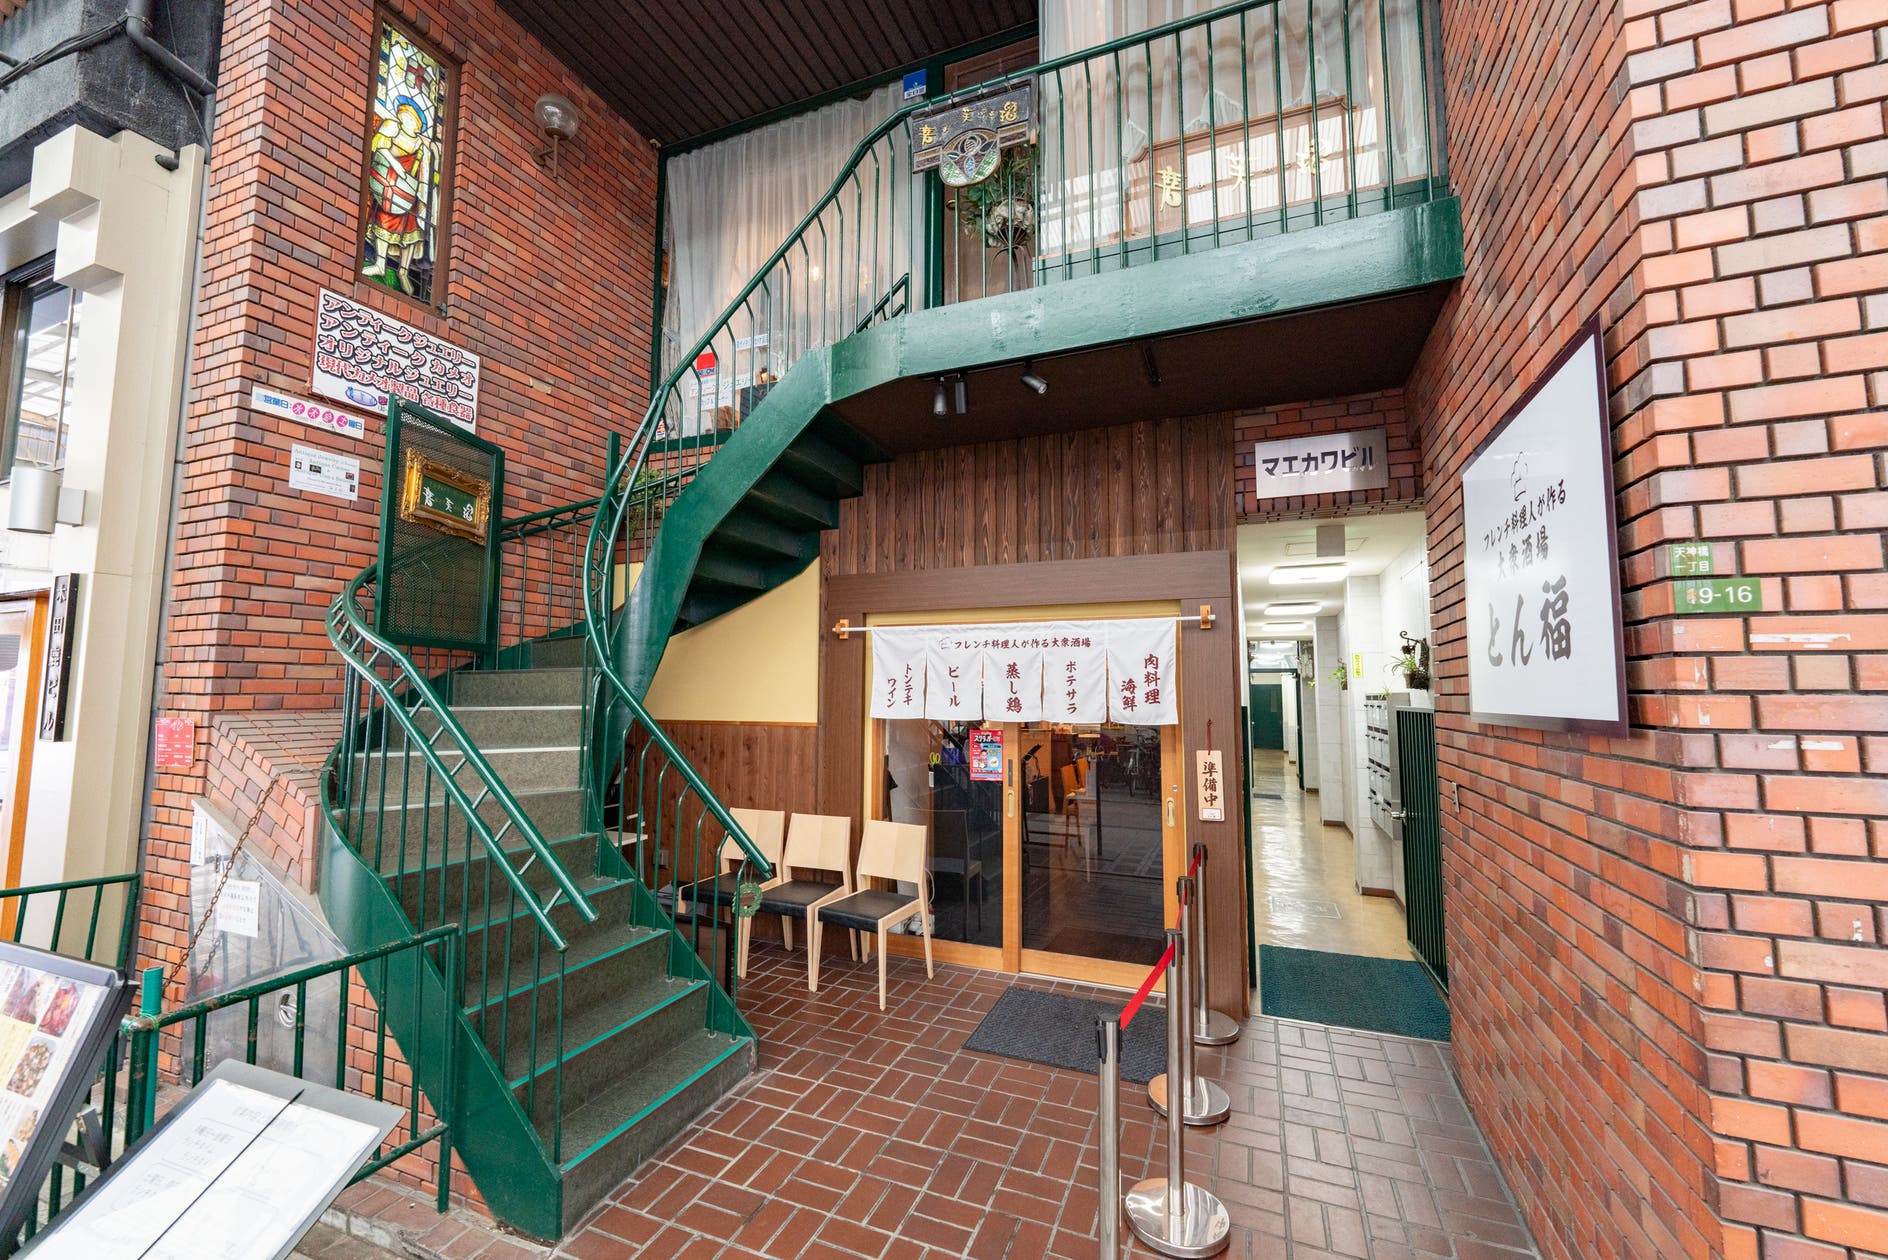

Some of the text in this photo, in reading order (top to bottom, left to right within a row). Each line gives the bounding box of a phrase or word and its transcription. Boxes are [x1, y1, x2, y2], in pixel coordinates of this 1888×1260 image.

[324, 294, 476, 368] アンティークジュエリー
[318, 334, 474, 401] オリジナルジュエリー
[1262, 446, 1374, 476] マエカワビル
[1484, 478, 1566, 552] フレンチ料理人が作る
[1497, 525, 1549, 582] 大衆酒場
[1674, 560, 1709, 572] 一丁目
[954, 636, 1091, 650] フレンチ料理人が作る大衆酒場
[1488, 574, 1572, 667] とん福
[886, 677, 897, 709] ワイン
[903, 663, 913, 706] トンテキ
[948, 665, 960, 708] ビール
[1006, 661, 1023, 714] 蒸し鶏
[1120, 678, 1138, 713] 海鮮
[1143, 653, 1161, 704] 肉料理
[1202, 761, 1218, 807] 準備中
